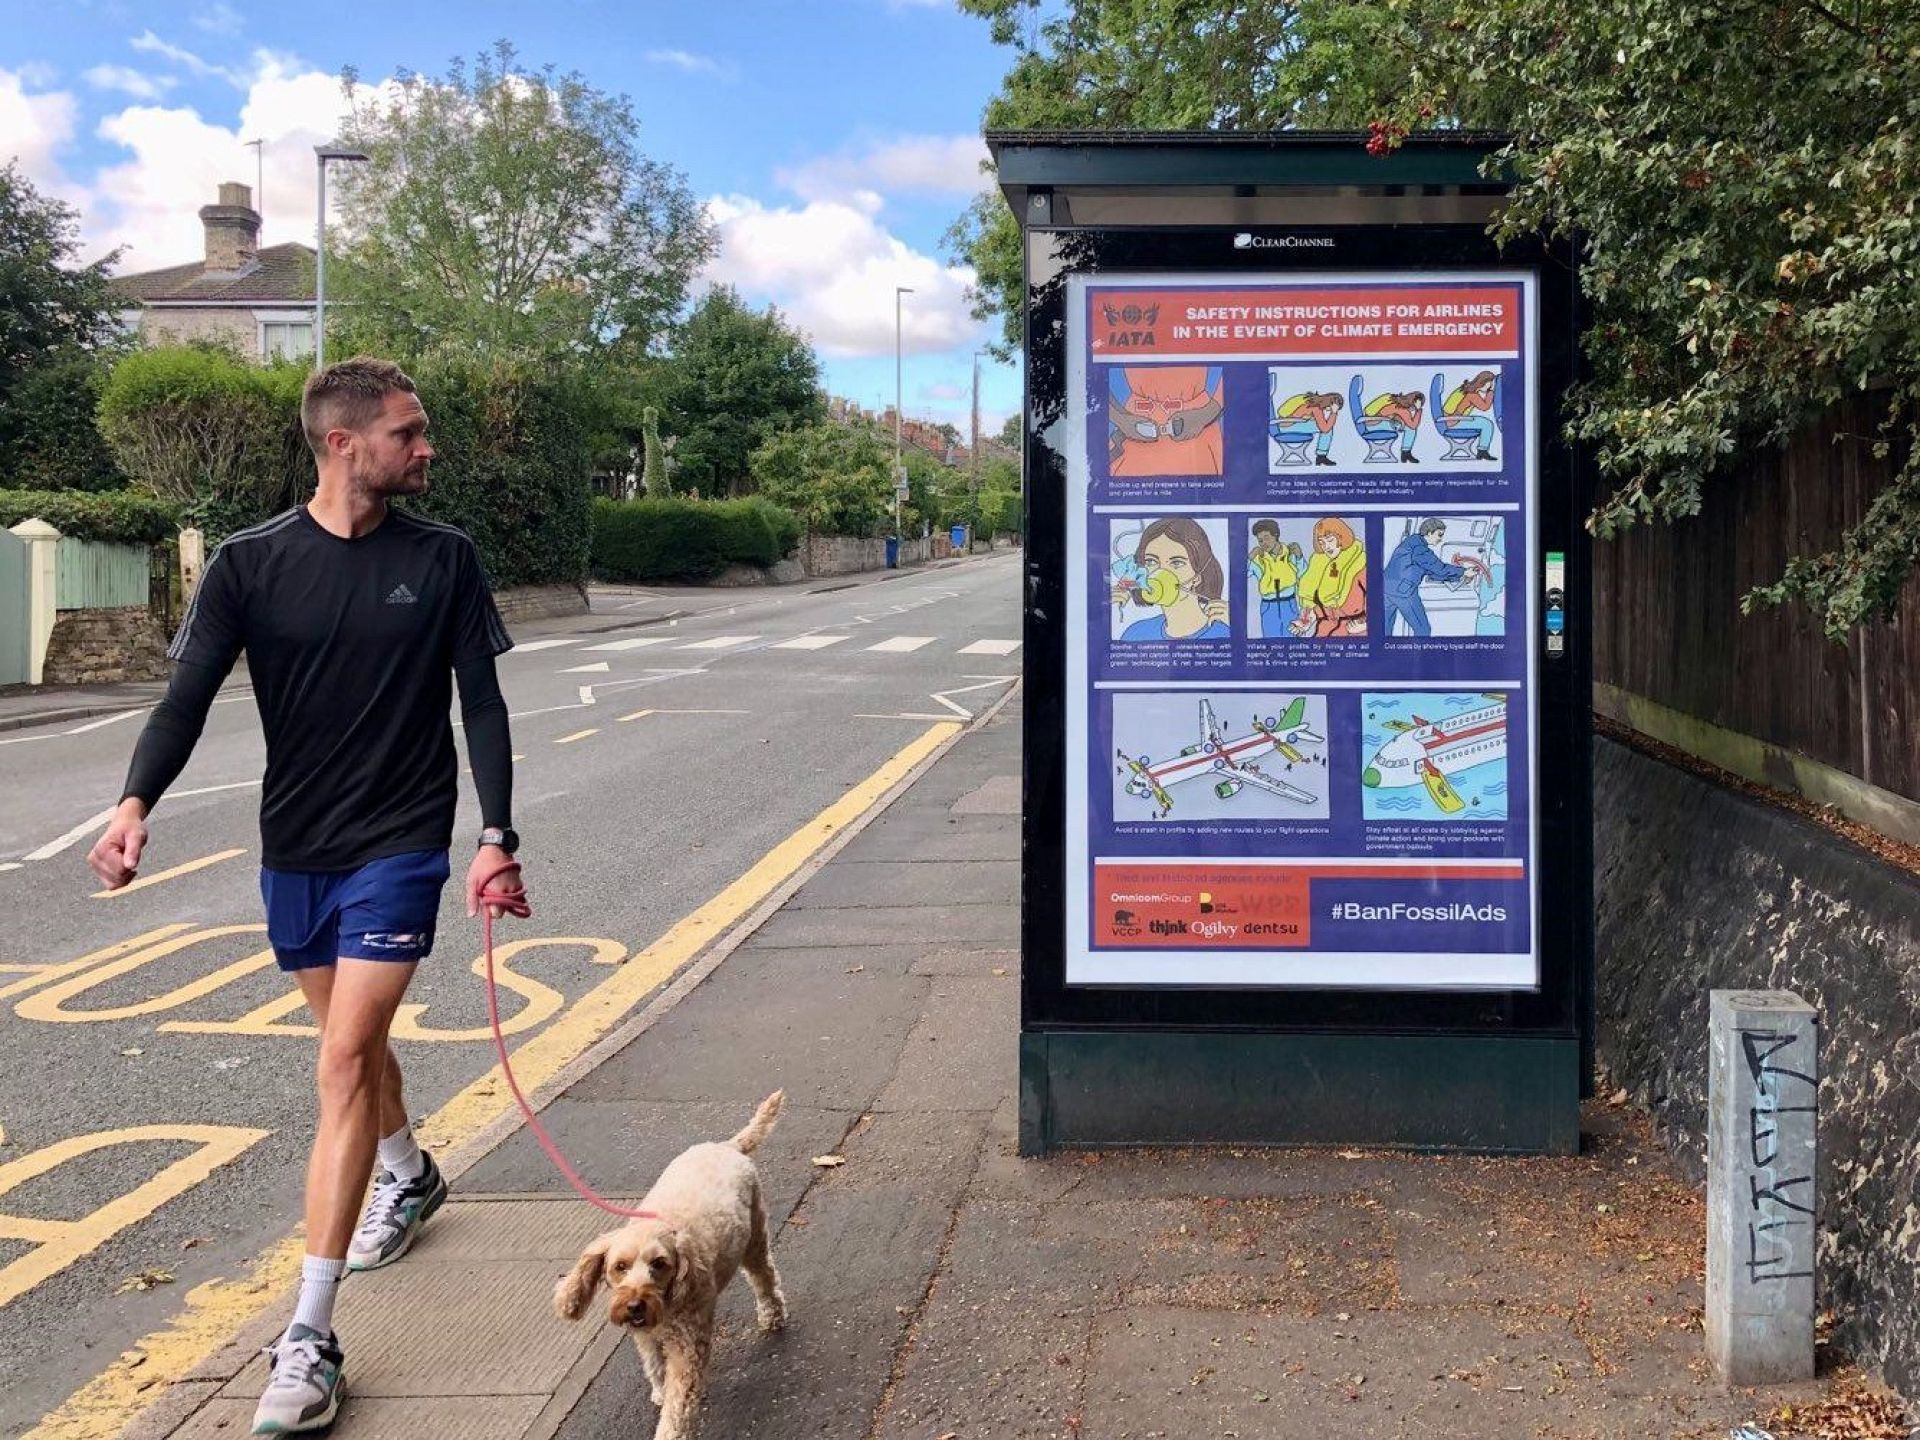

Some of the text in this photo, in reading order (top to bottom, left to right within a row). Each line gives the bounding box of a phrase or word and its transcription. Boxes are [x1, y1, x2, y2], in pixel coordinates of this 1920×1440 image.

[1186, 304, 1503, 320] SAFETY INSTRUCTIONS FOR AIRLINES
[1109, 331, 1155, 346] IATA
[1173, 322, 1504, 339] IN THE EVENT OF CLIMATE EMERGENCY
[1332, 903, 1507, 921] #BanFossilAds
[1112, 928, 1142, 937] VCCP
[1191, 920, 1238, 938] Ogilvy
[1243, 922, 1299, 935] dentsu
